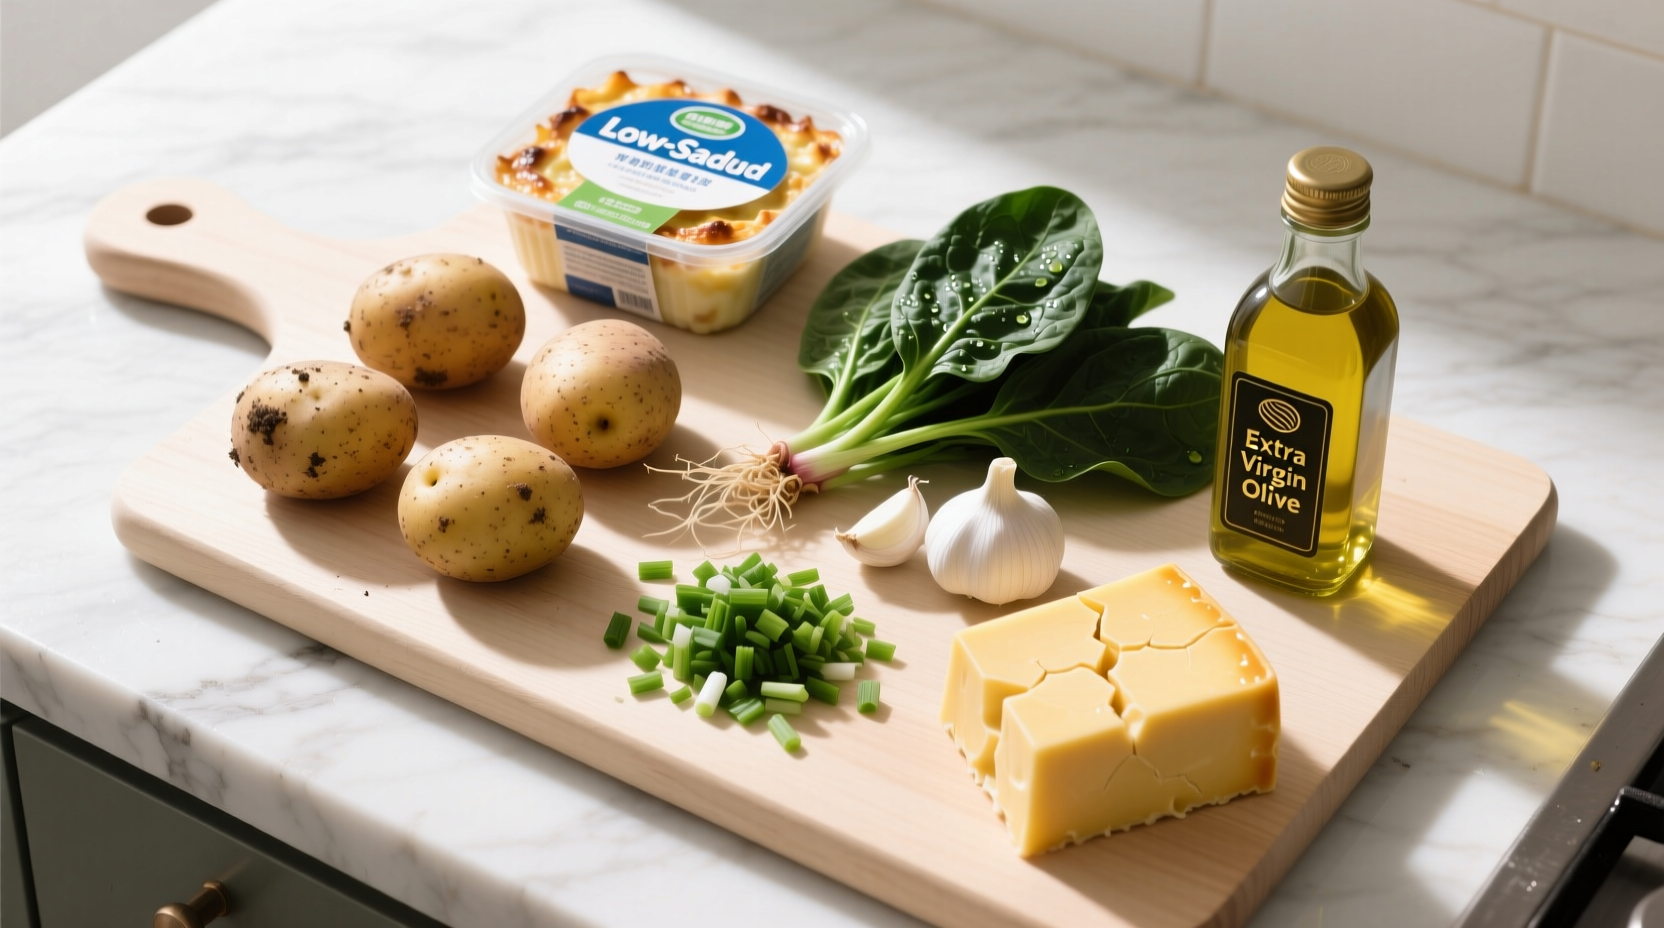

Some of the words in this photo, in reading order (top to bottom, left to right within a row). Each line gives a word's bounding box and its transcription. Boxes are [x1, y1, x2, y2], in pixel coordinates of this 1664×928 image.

[598, 116, 772, 181] Low-Sadud
[1245, 428, 1306, 467] Extra
[1240, 450, 1307, 491] Virgin
[1241, 478, 1301, 514] Olive
